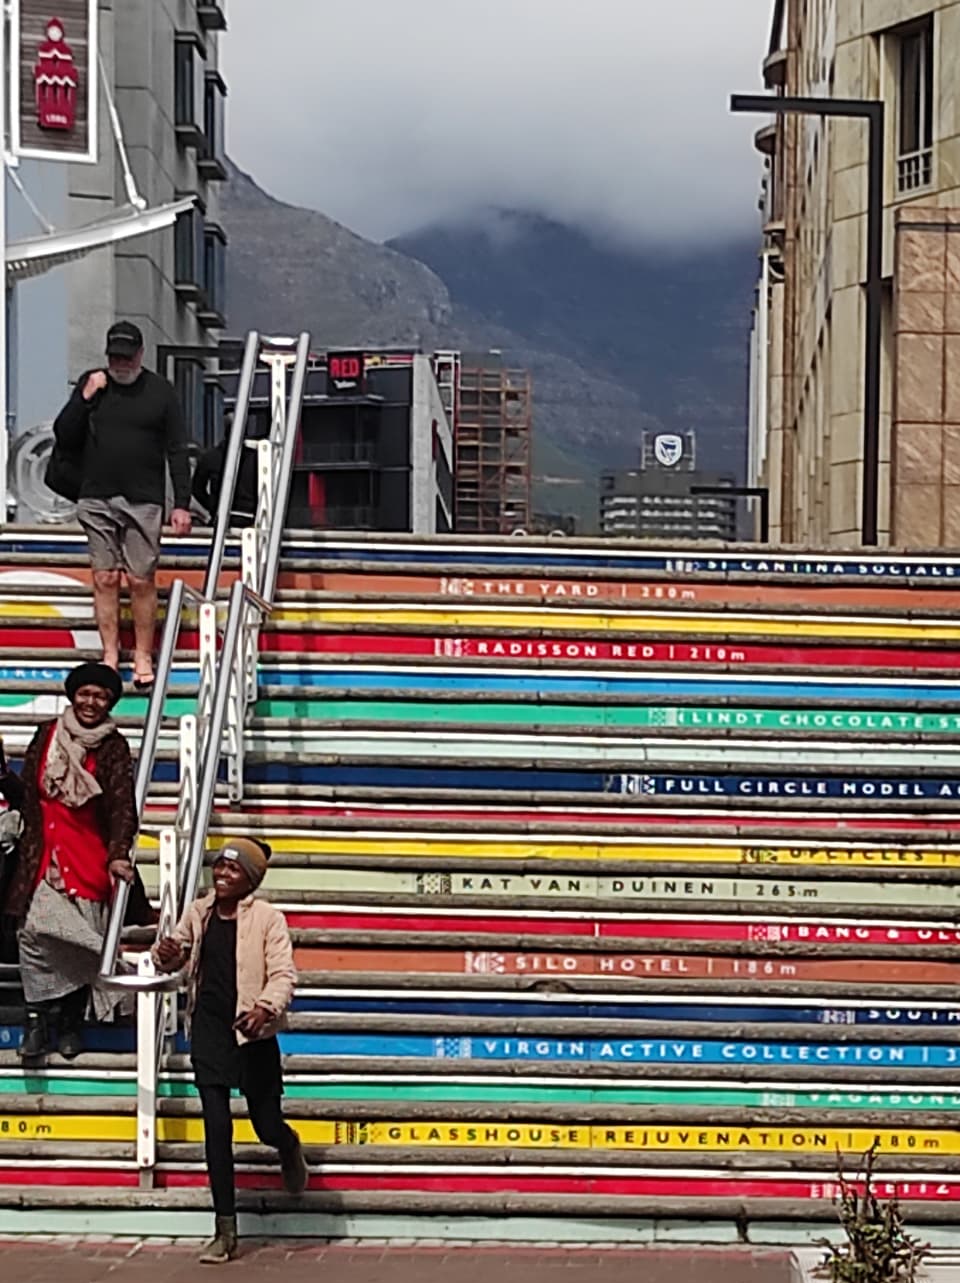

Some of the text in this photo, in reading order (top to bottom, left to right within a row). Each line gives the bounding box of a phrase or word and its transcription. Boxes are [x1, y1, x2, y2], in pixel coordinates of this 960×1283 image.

[330, 357, 359, 377] RED
[859, 564, 954, 576] SOCIALE
[482, 581, 525, 594] THE
[540, 583, 598, 597] YARD
[478, 642, 597, 657] RADISSON
[612, 644, 655, 658] RED
[690, 647, 745, 660] 210m
[693, 711, 764, 725] LINDT
[780, 713, 924, 728] CHOCOLATE
[665, 779, 725, 793] FULL
[739, 780, 827, 795] CIRCLE
[843, 783, 924, 796] MODEL
[462, 878, 513, 891] KAT
[530, 879, 581, 892] VAN
[612, 880, 715, 893] DUINEN
[756, 883, 818, 898] 265m
[799, 926, 869, 938] BANG
[516, 955, 578, 971] SILO
[600, 957, 689, 973] HOTEL
[483, 1041, 585, 1056] VIRGIN
[600, 1042, 703, 1057] ACTIVE
[722, 1044, 904, 1060] COLLECTION
[389, 1126, 580, 1142] GLASSHOUSE
[605, 1130, 827, 1146] REJUVENATION
